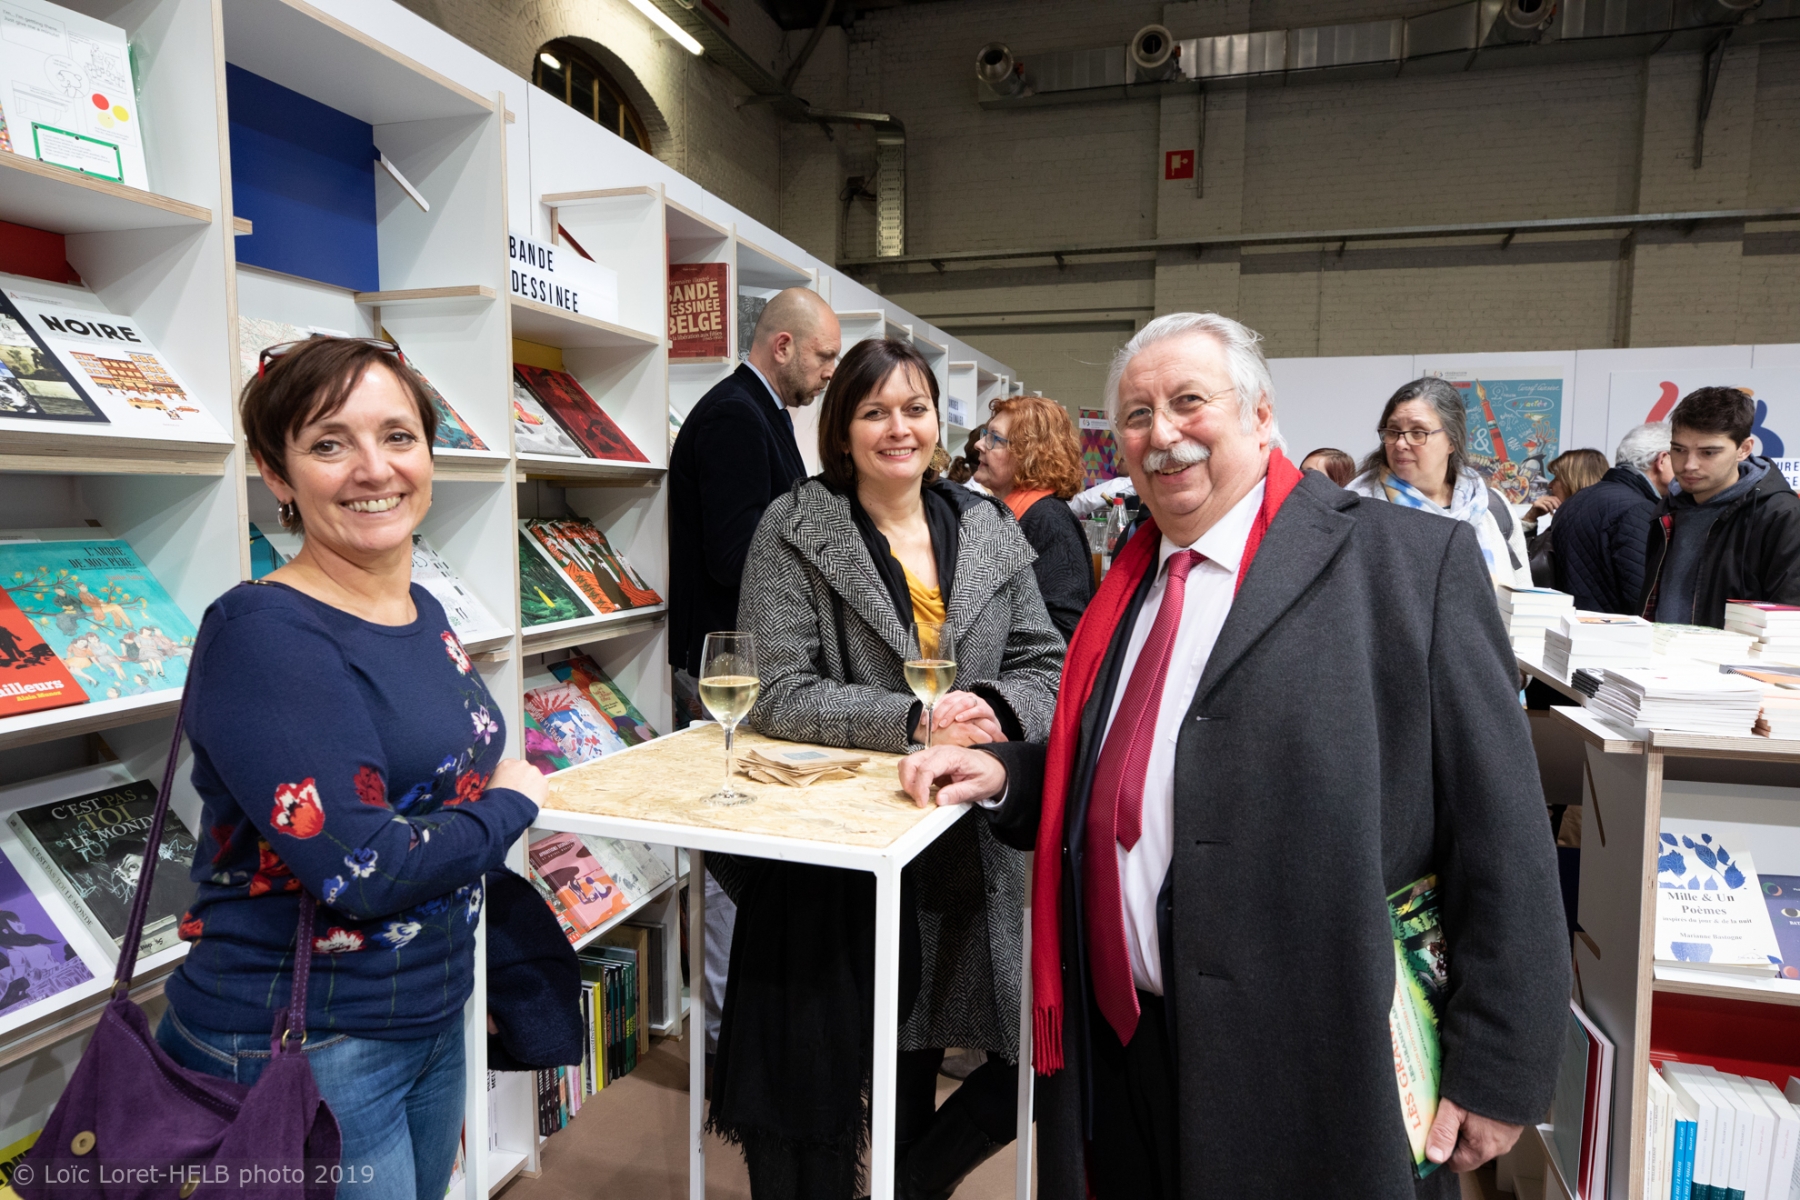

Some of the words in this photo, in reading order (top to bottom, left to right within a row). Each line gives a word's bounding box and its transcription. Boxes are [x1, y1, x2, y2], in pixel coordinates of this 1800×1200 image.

[509, 235, 554, 272] BANDE
[512, 270, 578, 313] DESSINEE
[38, 314, 141, 342] NOIRE
[670, 311, 722, 336] BELGE
[51, 798, 102, 820] C'EST
[102, 789, 137, 808] PAS
[77, 804, 136, 832] TOI
[66, 834, 95, 850] LE
[1668, 892, 1698, 902] Mille
[1702, 892, 1712, 902] &
[1717, 893, 1735, 902] Un
[1682, 904, 1727, 915] Poèmes
[72, 900, 94, 928] MONDE
[1396, 1022, 1410, 1064] GRANDS
[1408, 1064, 1416, 1083] LES
